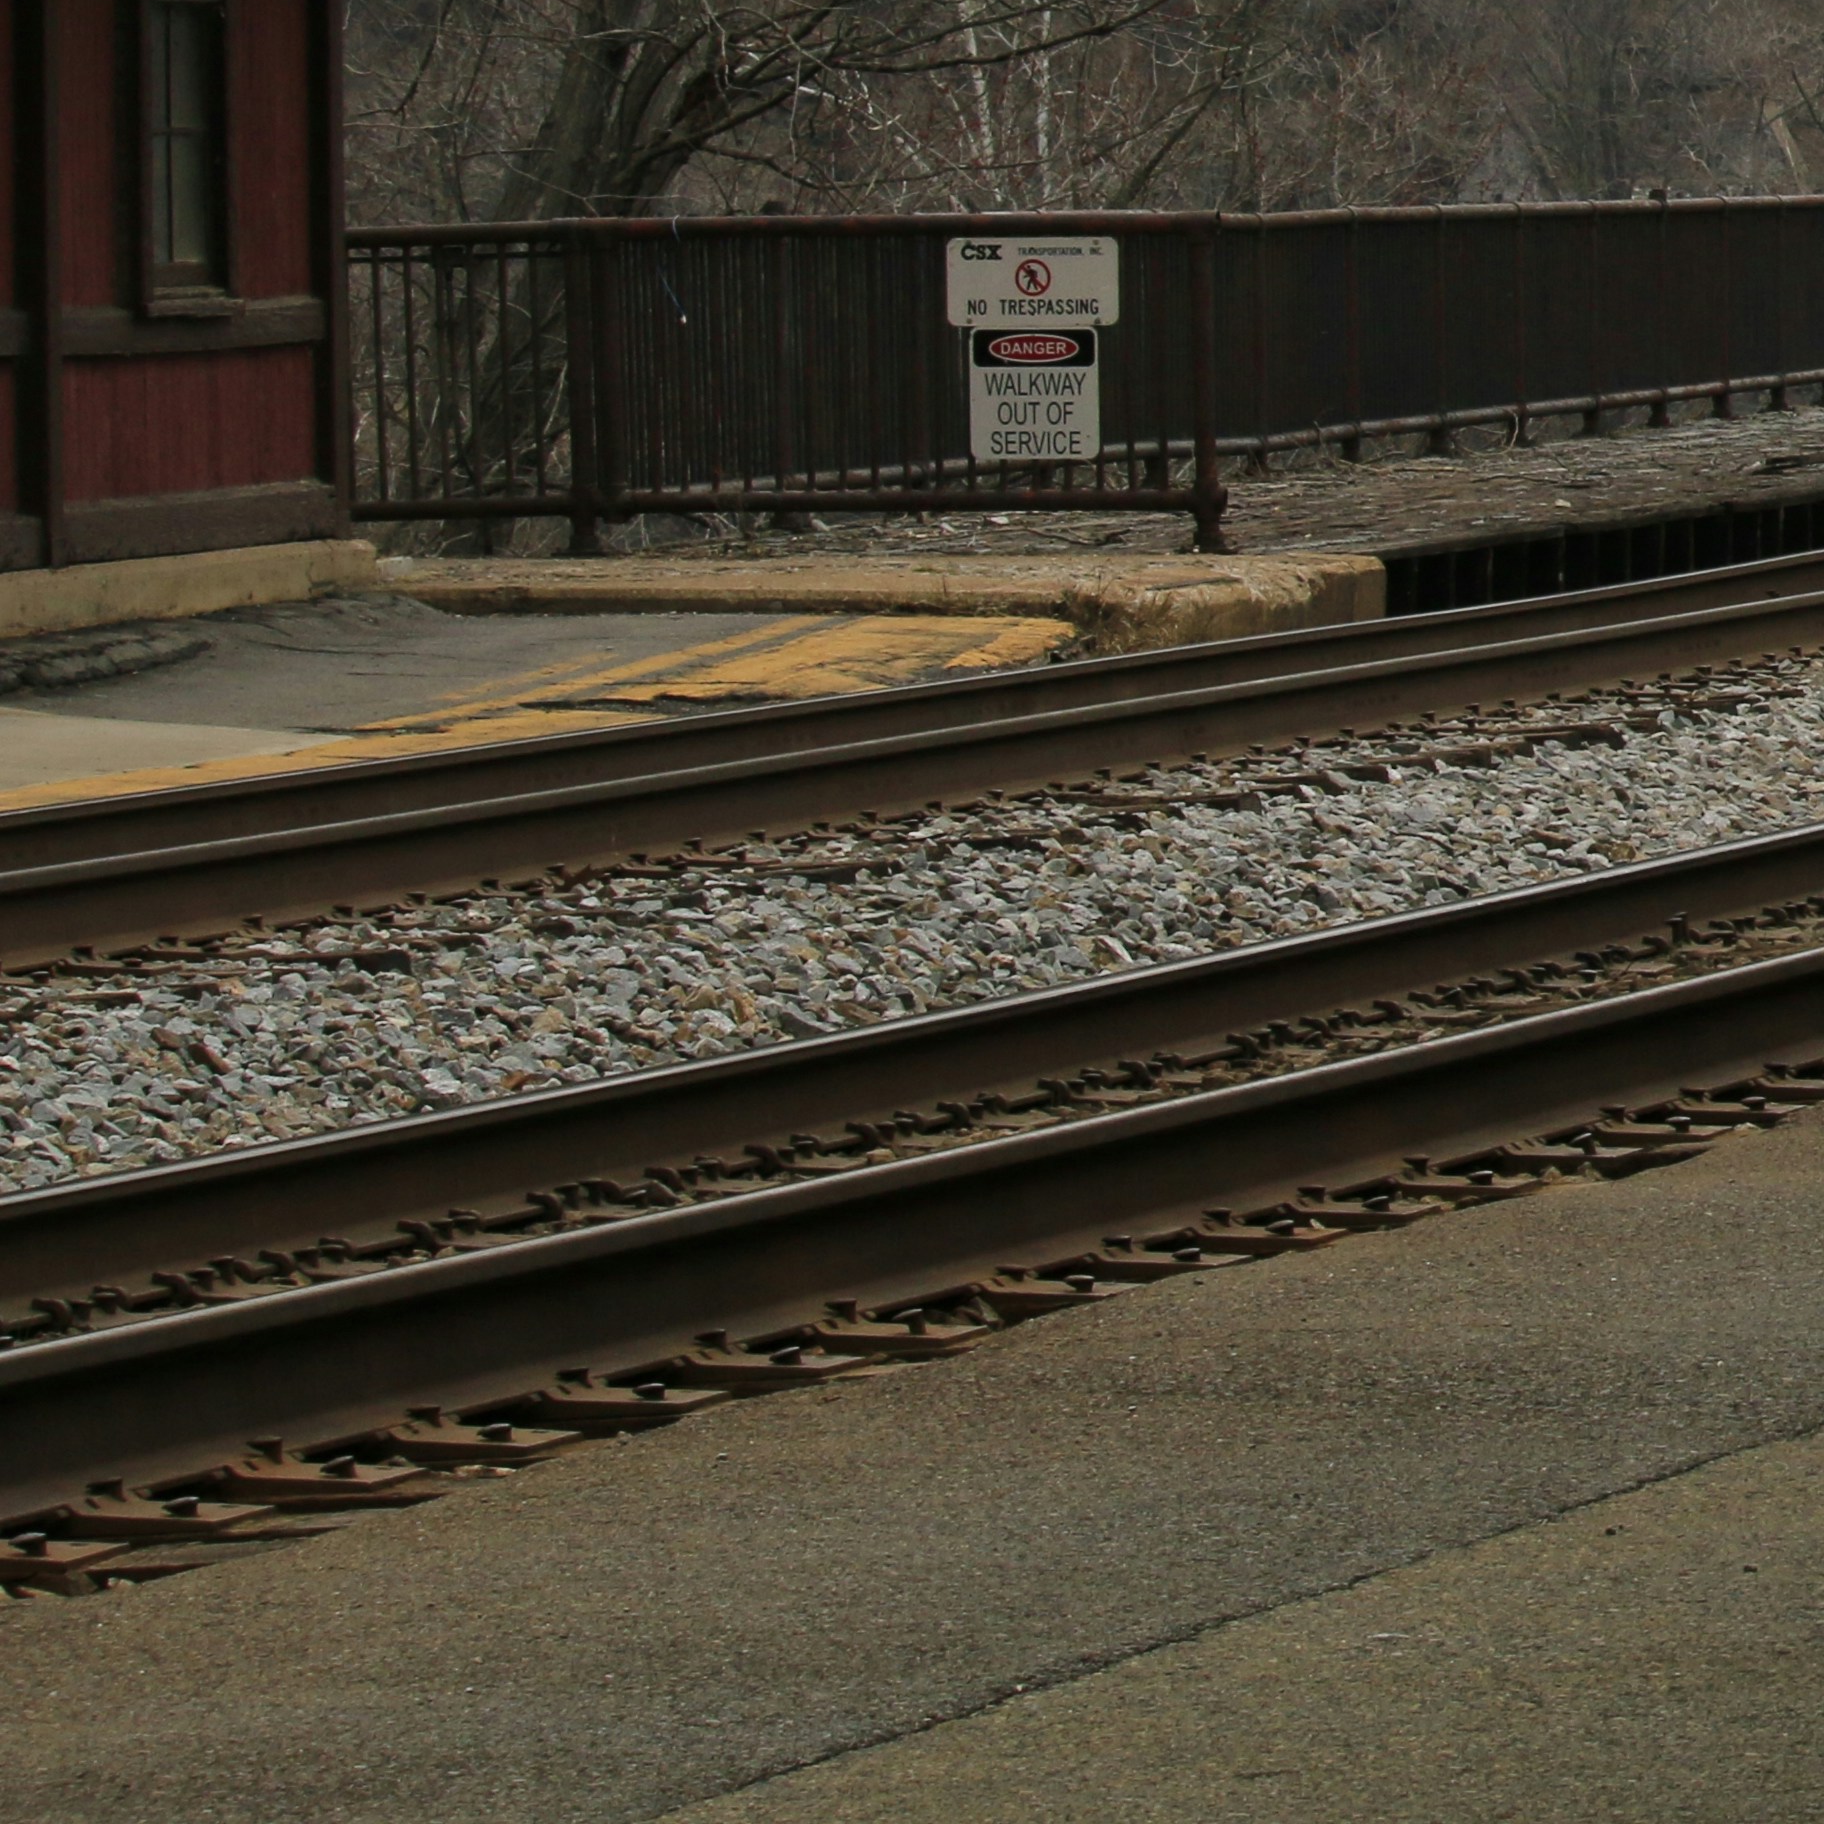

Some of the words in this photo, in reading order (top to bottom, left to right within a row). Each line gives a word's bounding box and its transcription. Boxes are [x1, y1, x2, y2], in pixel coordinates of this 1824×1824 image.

[961, 244, 1002, 261] CSX
[967, 299, 987, 315] NO
[1000, 299, 1099, 316] TRESPASSING
[1000, 342, 1067, 356] DANGER
[984, 373, 1086, 396] WALKWAY
[997, 402, 1040, 425] OUT
[1046, 402, 1074, 425] OF
[990, 431, 1082, 455] SERVICE
